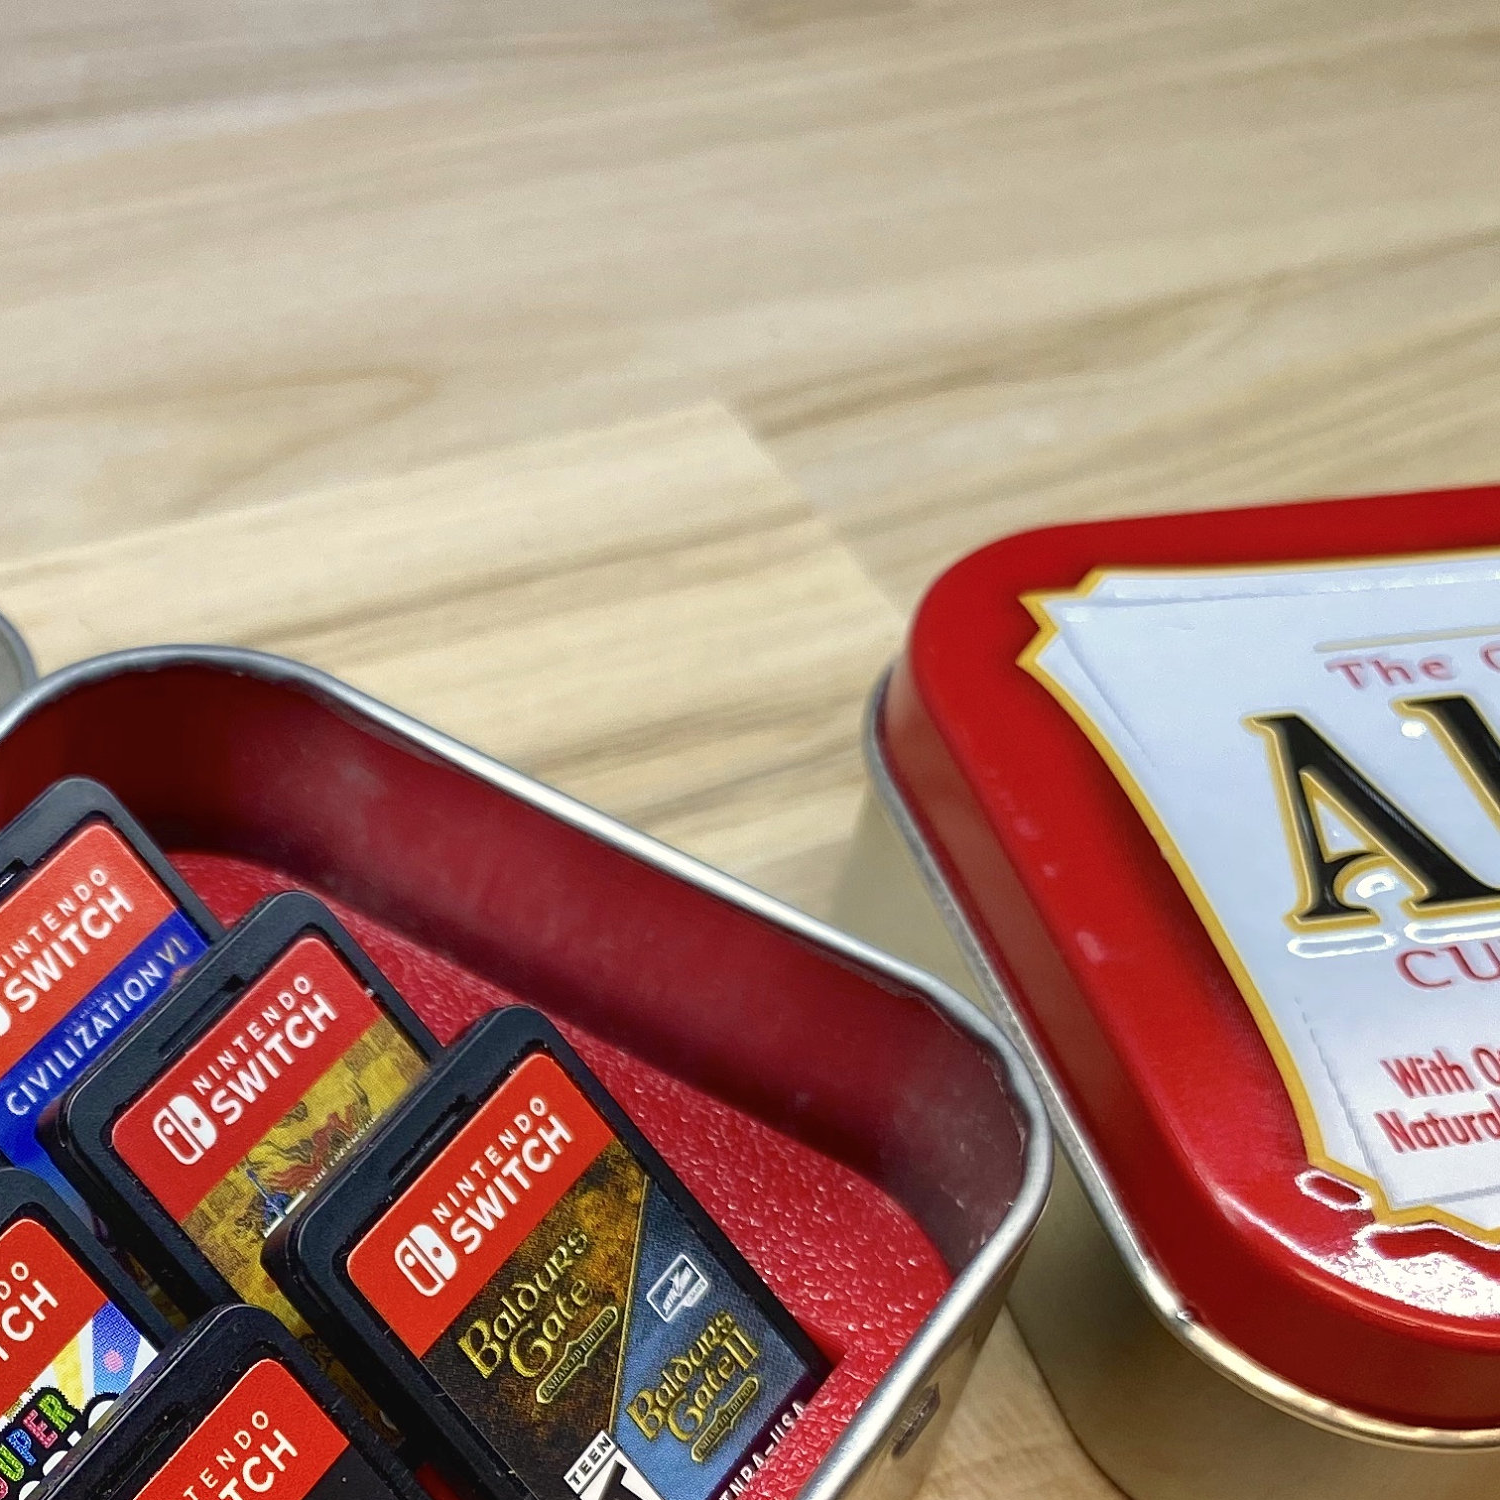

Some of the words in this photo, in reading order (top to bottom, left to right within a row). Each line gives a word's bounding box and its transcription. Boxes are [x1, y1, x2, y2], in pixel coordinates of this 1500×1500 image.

[1324, 653, 1457, 690] The
[4, 885, 133, 1013] SWITCH
[6, 960, 163, 1116] CIVILIZATION
[155, 937, 190, 966] VI
[192, 975, 314, 1091] NINTENDO
[210, 993, 338, 1126] SWITCH
[1378, 1047, 1476, 1099] With
[431, 1097, 547, 1224] NINTENDO
[450, 1115, 573, 1255] SWITCH
[508, 1278, 594, 1379] Gate
[568, 1436, 612, 1486] TEEN
